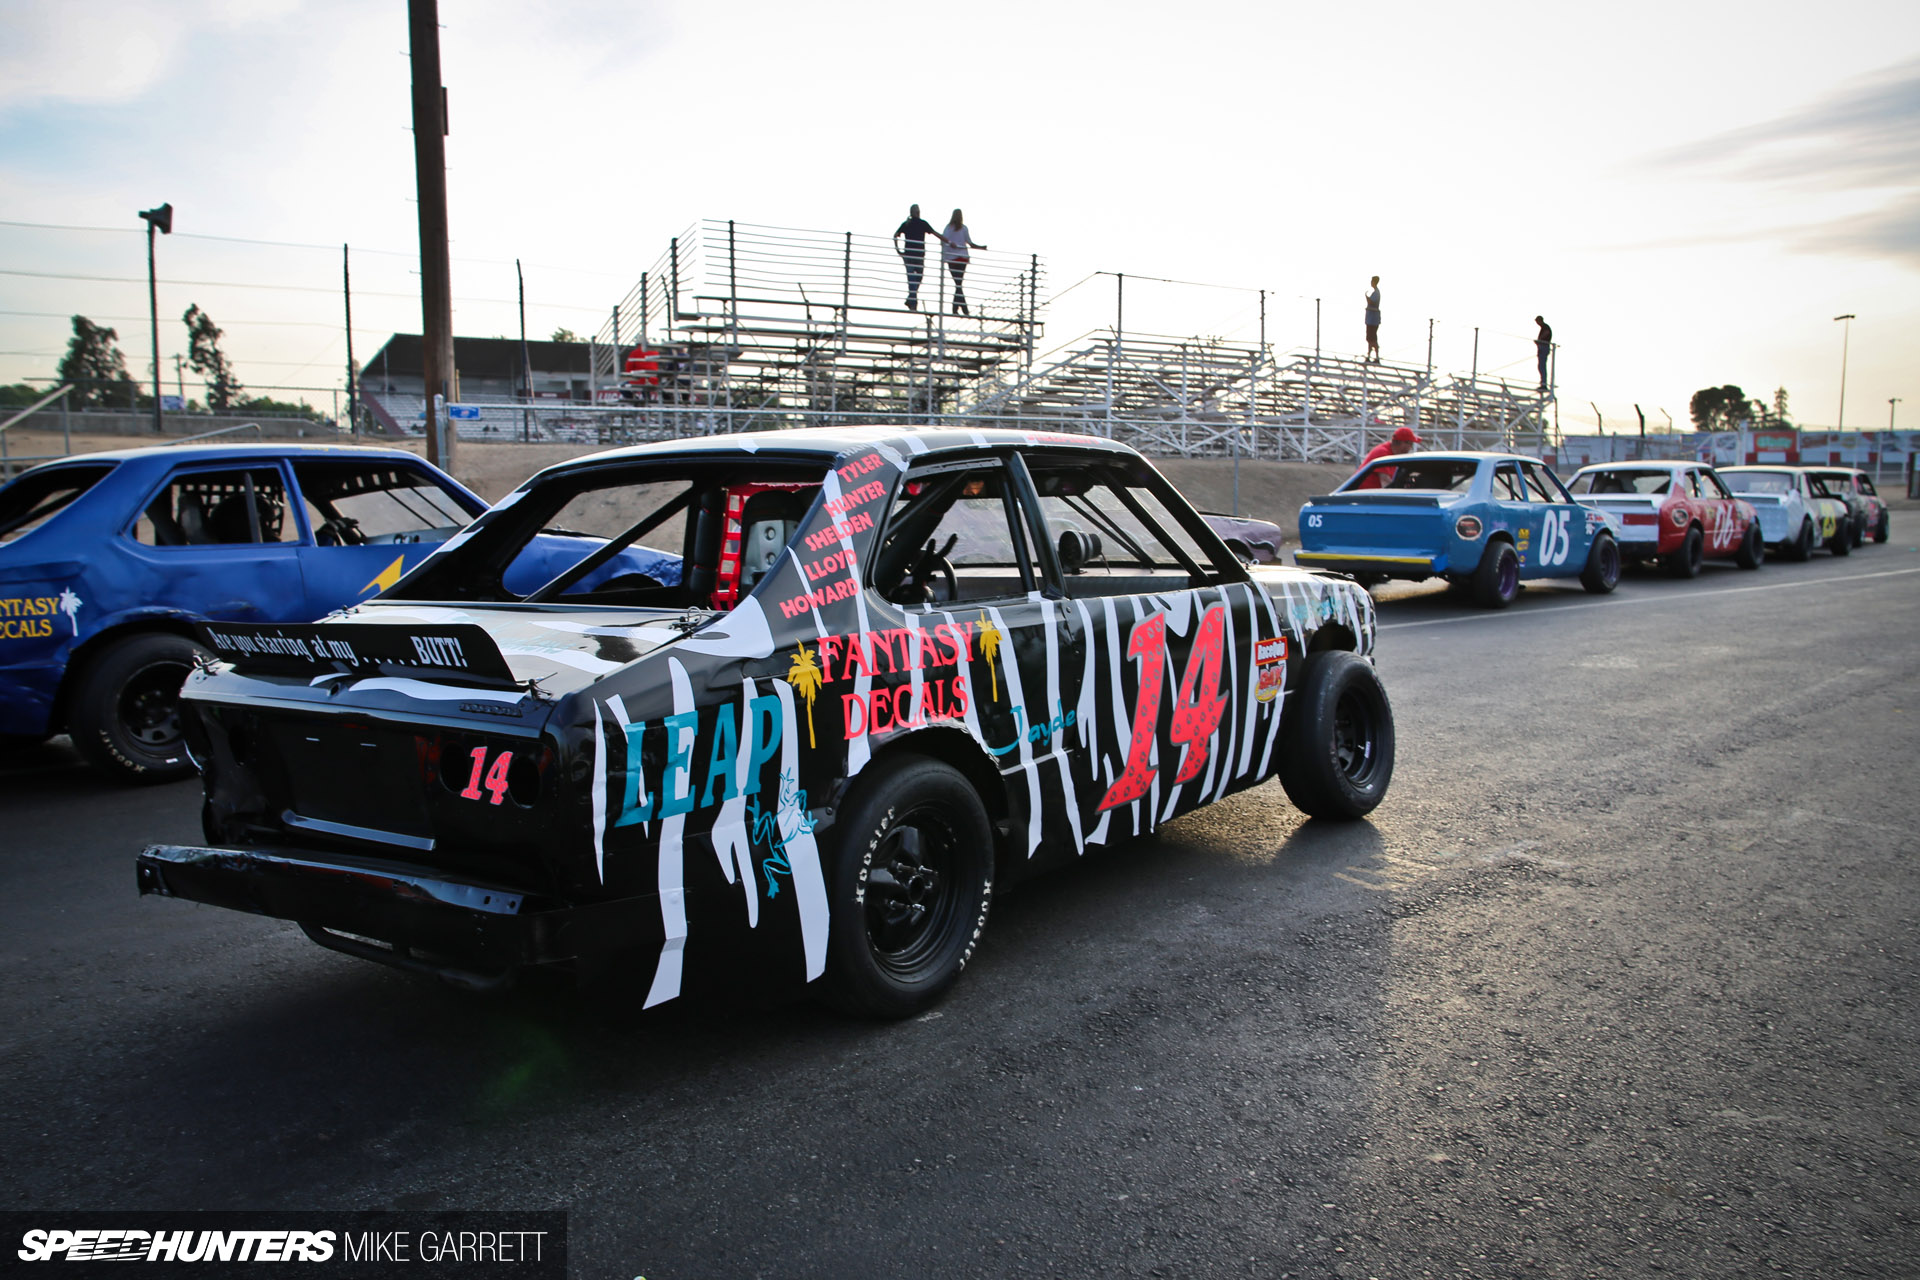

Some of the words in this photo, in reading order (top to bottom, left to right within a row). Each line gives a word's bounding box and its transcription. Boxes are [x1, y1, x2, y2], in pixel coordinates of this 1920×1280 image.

[837, 453, 885, 483] TYLER
[823, 480, 887, 518] HUNTER
[1308, 514, 1323, 528] 05
[804, 511, 874, 552] SHELDEN
[1539, 509, 1570, 566] 05
[803, 548, 857, 581] LLOYD
[779, 577, 859, 619] HOWARD
[206, 626, 237, 651] Are
[230, 634, 260, 657] you
[311, 634, 332, 658] at
[327, 640, 360, 667] my
[409, 636, 468, 668] BUTT!
[816, 621, 975, 685] FANTASY
[841, 675, 969, 740] DECALS
[986, 698, 1076, 756] Jayde
[1095, 600, 1231, 815] 14
[460, 745, 514, 806] 14
[614, 694, 784, 829] LEAP
